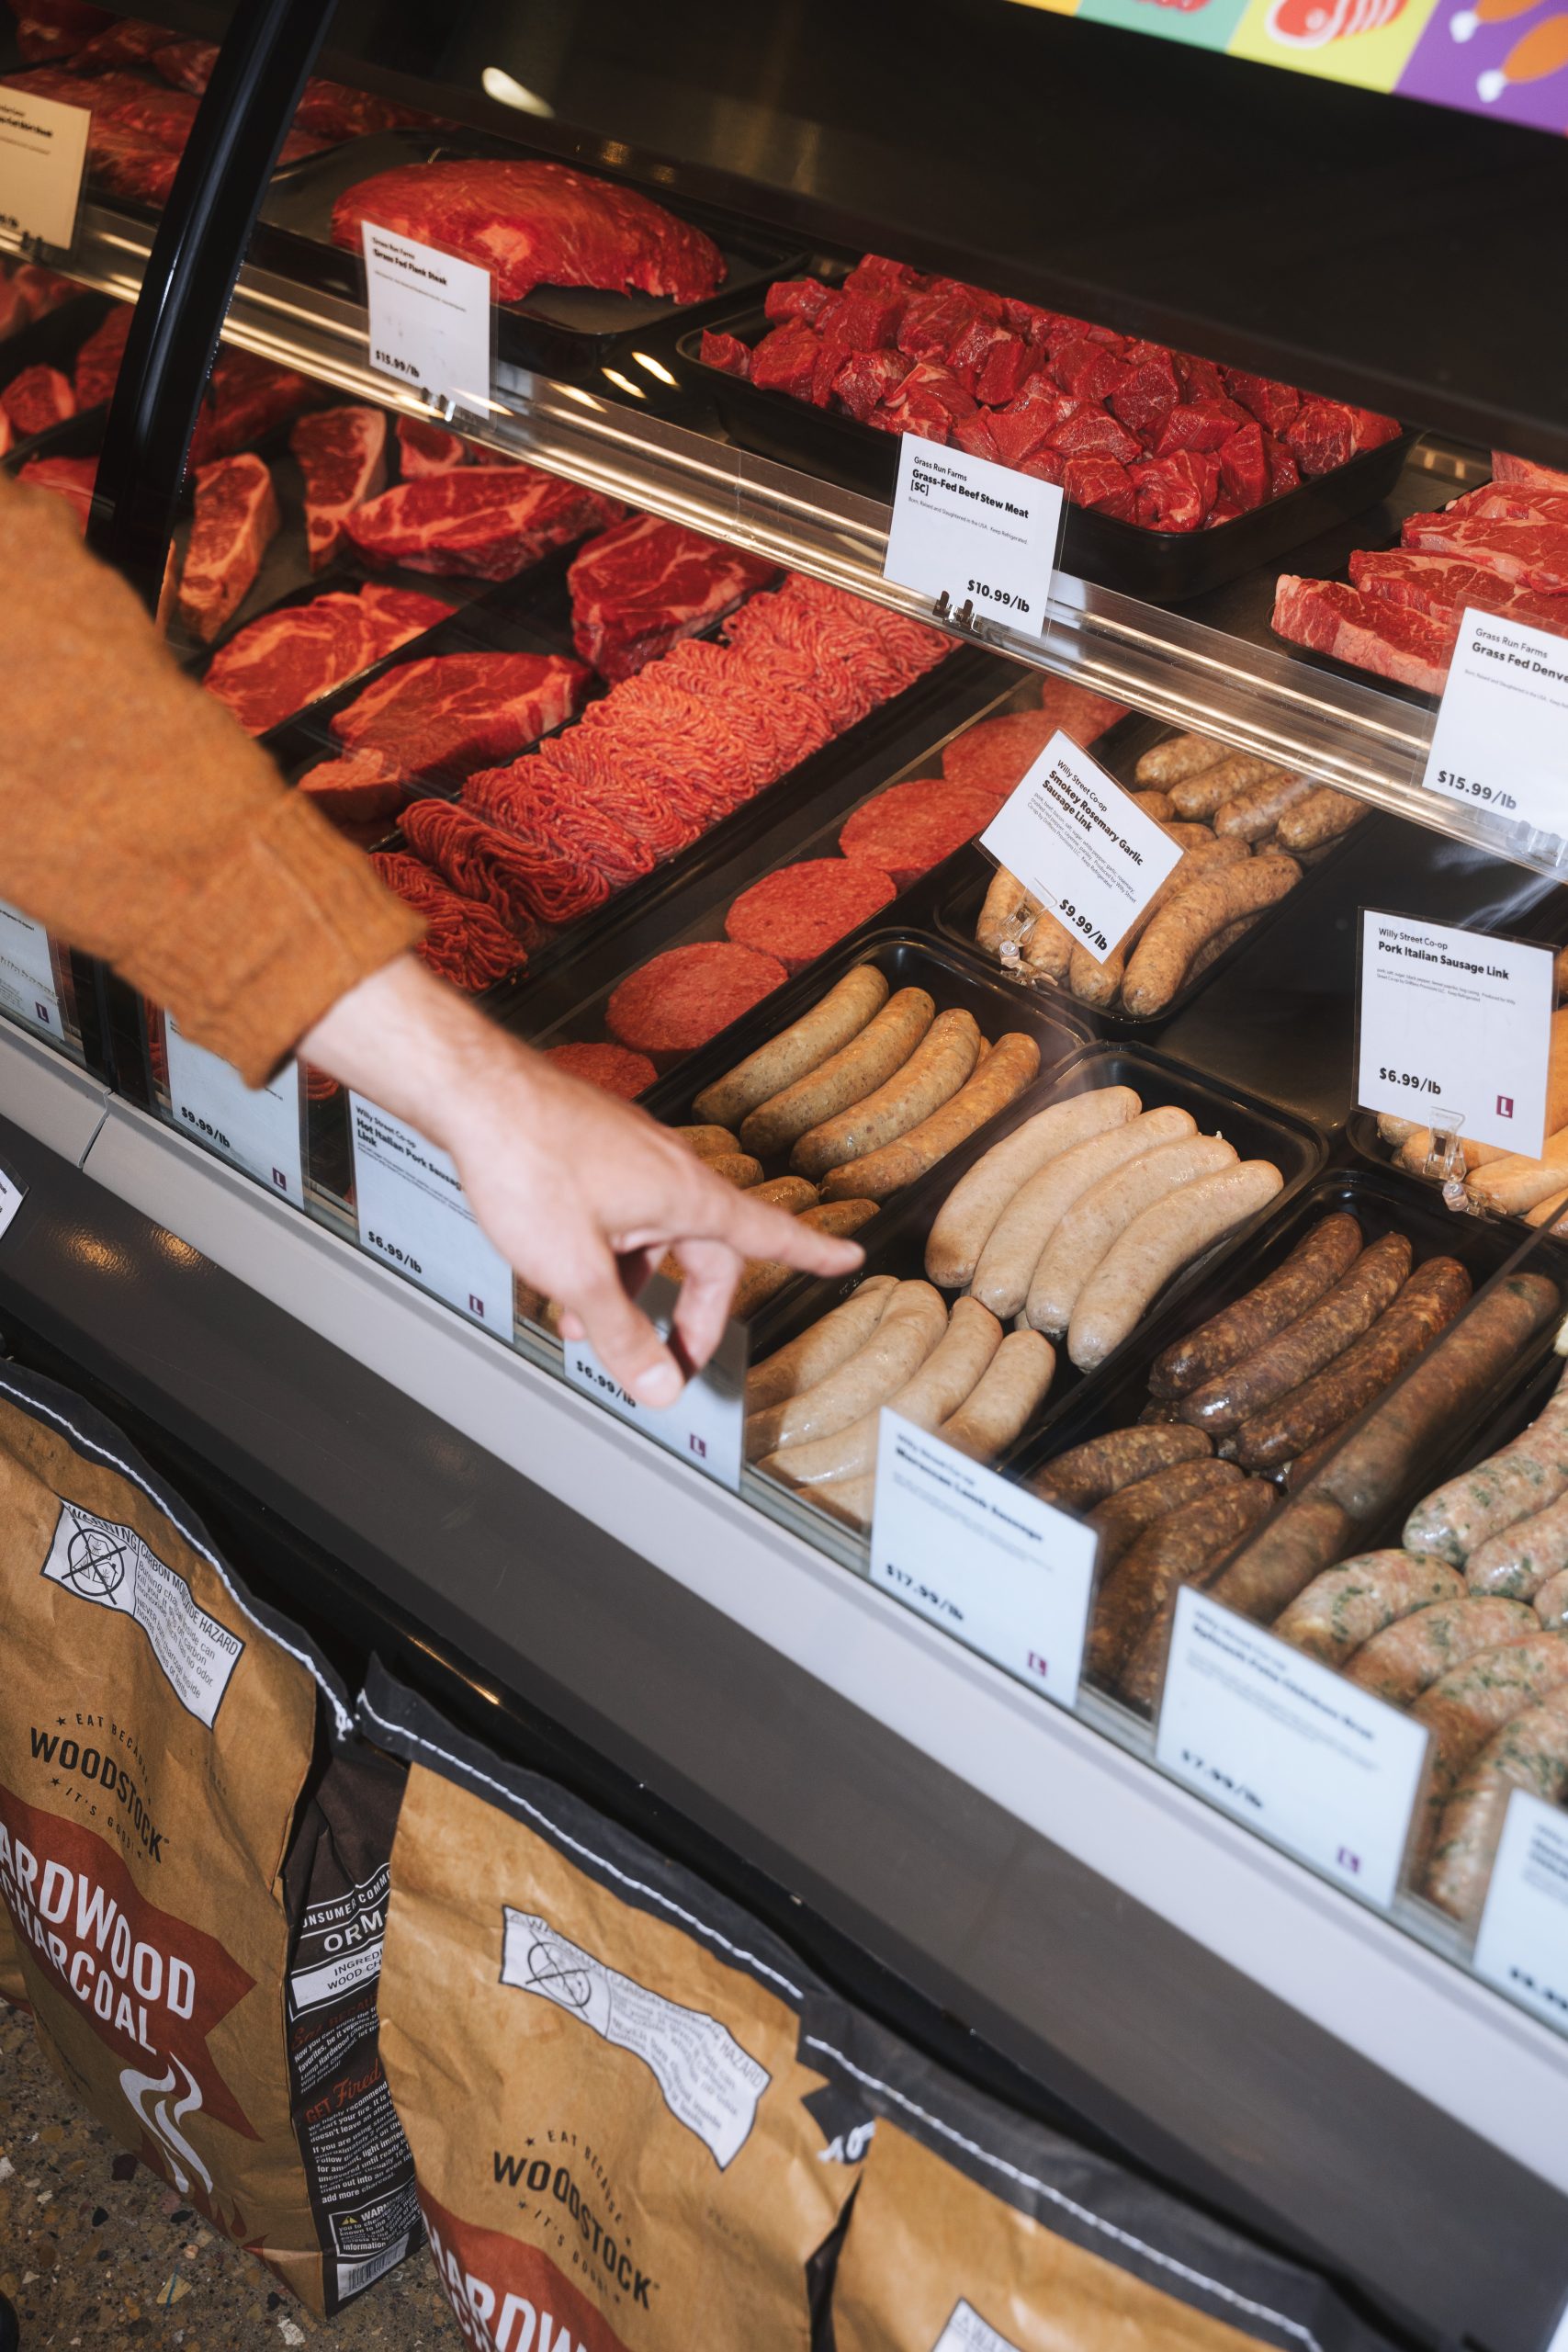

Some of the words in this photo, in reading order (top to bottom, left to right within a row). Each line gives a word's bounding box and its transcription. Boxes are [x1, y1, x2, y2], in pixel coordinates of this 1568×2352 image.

[373, 248, 394, 264] Grass
[395, 258, 407, 269] Fed
[409, 264, 426, 277] Flank
[428, 271, 447, 285] Steak
[376, 350, 420, 378] $15.99/lb
[910, 480, 930, 496] [SC]
[914, 456, 932, 469] Grass
[933, 463, 946, 474] Run
[947, 469, 967, 481] Farms
[912, 469, 957, 492] Grass-Fed
[959, 485, 980, 501] Beef
[980, 493, 1004, 509] Stew
[1005, 503, 1030, 519] Meat
[967, 579, 1030, 613] $10.99/lb
[1472, 641, 1506, 662] Grass
[1507, 654, 1530, 670] Fed
[1475, 627, 1501, 644] Grass
[1502, 637, 1519, 650] Run
[1520, 643, 1549, 659] Farms
[1042, 779, 1076, 815] Sausage
[1074, 810, 1093, 832] Link
[1057, 759, 1073, 778] Willy
[1073, 775, 1090, 796] Street
[1089, 792, 1108, 813] Co-op
[1437, 770, 1517, 810] $15.99/lb
[1049, 770, 1081, 805] Smokey
[1080, 800, 1120, 842] Rosemary
[1119, 840, 1144, 866] Garlic
[1059, 899, 1108, 951] $9.99/lb
[1378, 927, 1398, 941] Willy
[1400, 932, 1423, 944] Street
[1424, 937, 1449, 951] Co-op
[1378, 941, 1403, 956] Pork
[1404, 946, 1438, 963] Italian
[1440, 955, 1484, 975] Sausage
[1486, 965, 1510, 980] Link
[1379, 1067, 1442, 1095] $6.99/lb
[181, 1106, 231, 1148] $9.99/lb
[356, 1105, 373, 1123] Willy
[374, 1117, 395, 1134] Street
[395, 1130, 416, 1148] Co-op
[358, 1129, 378, 1148] Link
[356, 1117, 374, 1135] Hot
[375, 1128, 405, 1154] Italian
[405, 1148, 427, 1169] Pork
[429, 1162, 463, 1192] Sausag
[368, 1231, 423, 1274] $6.99/lb
[577, 1360, 637, 1408] $6.99/lb
[138, 1561, 163, 1594] Burning
[184, 1621, 199, 1646] inside
[200, 1643, 215, 1660] can
[138, 1571, 148, 1588] kill
[147, 1586, 160, 1600] you.
[184, 1637, 207, 1666] carbon
[141, 1544, 171, 1582] CARBON
[173, 1575, 200, 1624] MONOXIDE
[199, 1618, 239, 1657] HAZARD
[136, 1582, 168, 1618] monoxide
[186, 1656, 195, 1669] no
[196, 1667, 214, 1688] odor.
[136, 1597, 157, 1623] NEVER
[156, 1621, 165, 1643] burn
[164, 1641, 184, 1675] charcoal
[183, 1674, 201, 1699] inside
[175, 1674, 188, 1701] tents.
[75, 1713, 104, 1728] EAT
[112, 1724, 149, 1786] BECAUSE
[30, 1726, 164, 1864] WOODSTOCK
[65, 1787, 97, 1816] IT'S
[107, 1815, 135, 1850] GOOD!
[0, 1868, 158, 2056] CHARCOAL
[327, 1968, 363, 1990] WOOD
[294, 2047, 308, 2064] Now
[309, 2038, 321, 2052] you
[321, 2029, 335, 2040] can
[357, 2010, 369, 2019] the
[298, 2045, 327, 2074] favorites,
[327, 2036, 336, 2047] be
[358, 2030, 368, 2039] let
[300, 2064, 319, 2082] Lump
[318, 2036, 350, 2066] Hardwood
[720, 2040, 765, 2089] HAZARD
[305, 2097, 333, 2124] GET
[333, 2058, 382, 2109] Fired
[309, 2124, 321, 2132] We
[321, 2109, 344, 2125] highly
[346, 2081, 389, 2113] recommend
[310, 2128, 340, 2143] doesn't
[340, 2121, 362, 2134] leave
[363, 2113, 373, 2123] an
[319, 2120, 338, 2132] start
[338, 2113, 356, 2125] your
[357, 2104, 373, 2118] fire.
[373, 2098, 379, 2107] It
[312, 2145, 320, 2154] If
[321, 2143, 336, 2152] you
[337, 2137, 352, 2148] are
[353, 2126, 373, 2141] using
[316, 2155, 343, 2164] Follow
[344, 2135, 378, 2162] directions
[379, 2129, 389, 2138] on
[317, 2165, 330, 2173] for
[331, 2154, 362, 2173] amount,
[362, 2143, 379, 2158] light
[318, 2165, 360, 2183] uncovered
[362, 2155, 378, 2169] until
[380, 2143, 400, 2160] ready
[342, 2179, 355, 2188] out
[356, 2174, 373, 2184] into
[386, 2160, 402, 2174] even
[547, 2130, 578, 2147] EAT
[584, 2145, 623, 2224] BECAUSE
[321, 2194, 337, 2205] add
[338, 2188, 360, 2199] more
[362, 2172, 396, 2193] charcoal.
[494, 2150, 651, 2311] WOODSTOCK
[535, 2210, 565, 2247] IT'S
[572, 2251, 609, 2297] GOOD!
